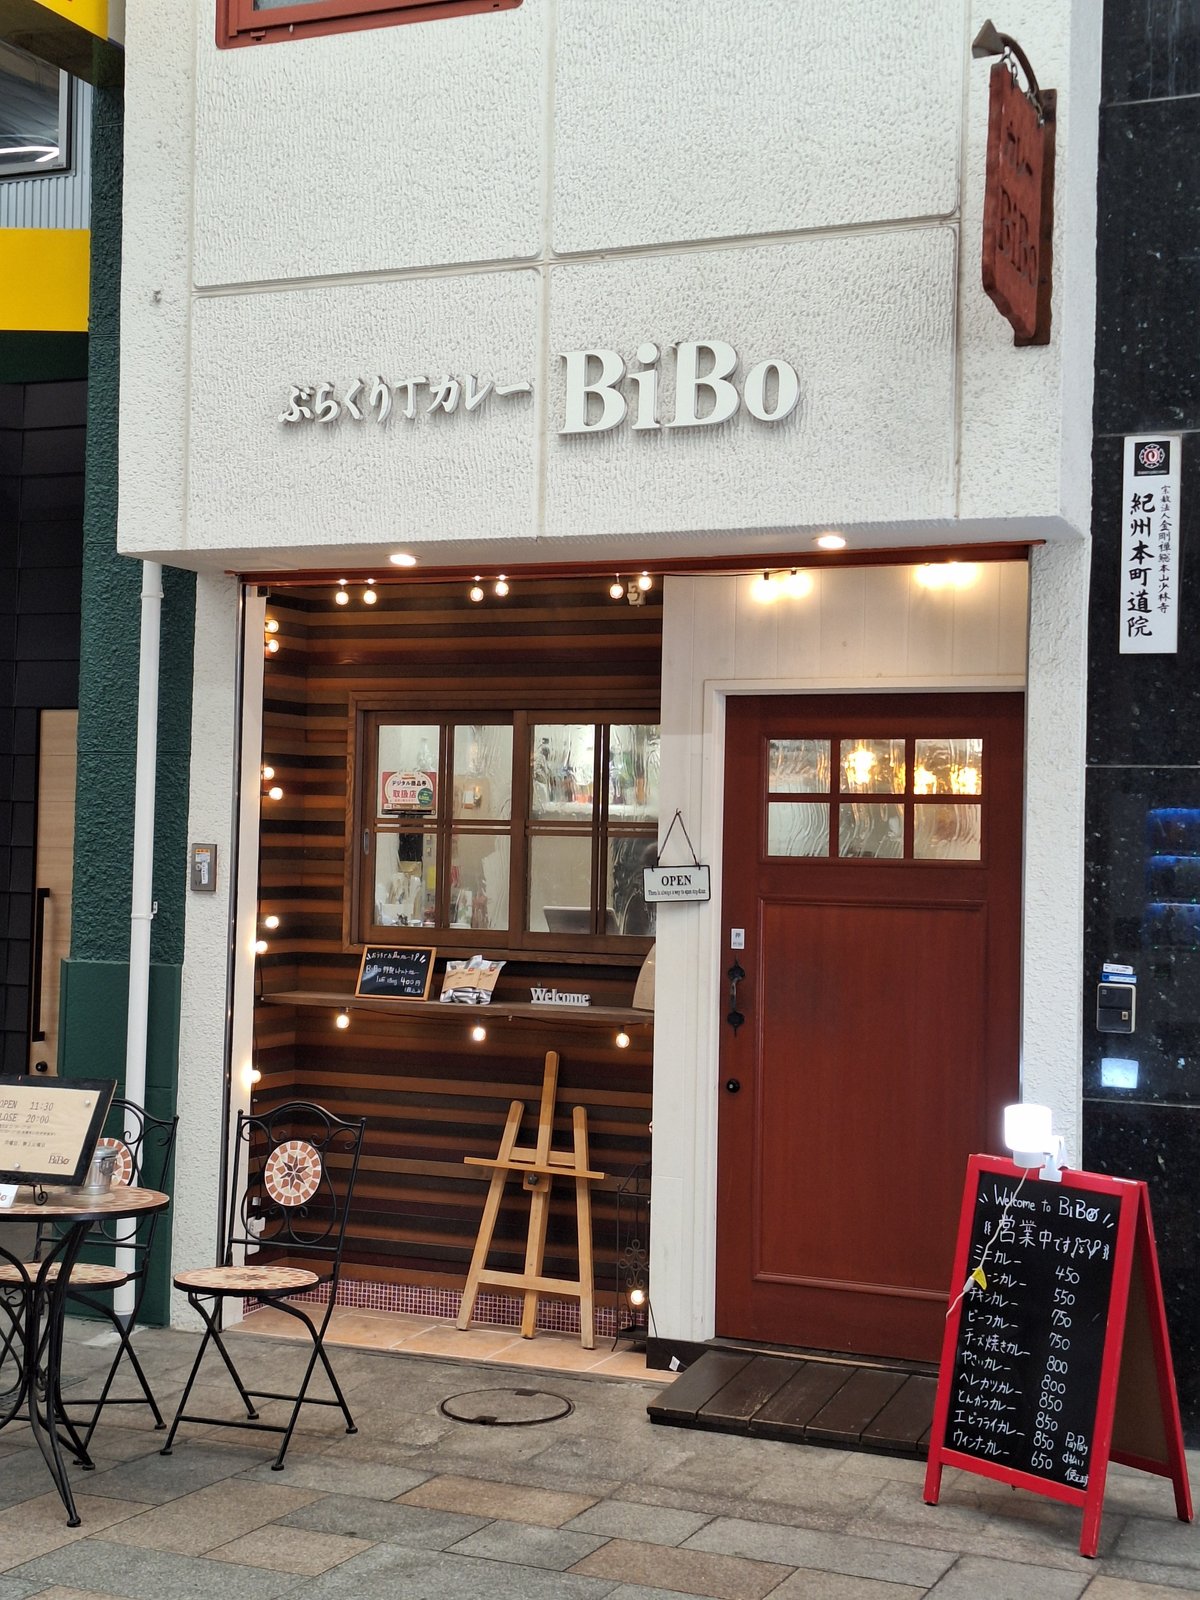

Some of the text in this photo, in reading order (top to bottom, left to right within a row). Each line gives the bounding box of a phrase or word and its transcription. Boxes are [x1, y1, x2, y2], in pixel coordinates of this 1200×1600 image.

[997, 184, 1038, 288] BiBo
[277, 340, 803, 435] ぶらくり丁カレー BiBo
[1127, 492, 1156, 638] 紀州本町道院
[392, 789, 417, 799] 取扱店
[661, 874, 692, 887] OPEN
[530, 987, 591, 1004] Welcome
[0, 1112, 50, 1124] LOSE 20:00
[29, 1101, 54, 1111] 11:30
[994, 1184, 1036, 1212] Welcome
[998, 1214, 1070, 1253] 営業中です
[1055, 1265, 1080, 1285] 450
[969, 1287, 1072, 1328] チキンカレー 750
[1053, 1288, 1076, 1306] 550
[968, 1309, 1071, 1350] ビーフカレー 750
[964, 1328, 1068, 1374] チーズ焼きカレー 800
[961, 1350, 1066, 1394] やさいカレー 800
[958, 1390, 1058, 1431] とんかつカレー 850
[959, 1372, 1063, 1412] ヘレカツカレー 850
[953, 1409, 1054, 1451] エビフライカレー 850
[1065, 1431, 1088, 1456] PayPay
[1031, 1451, 1053, 1470] 650
